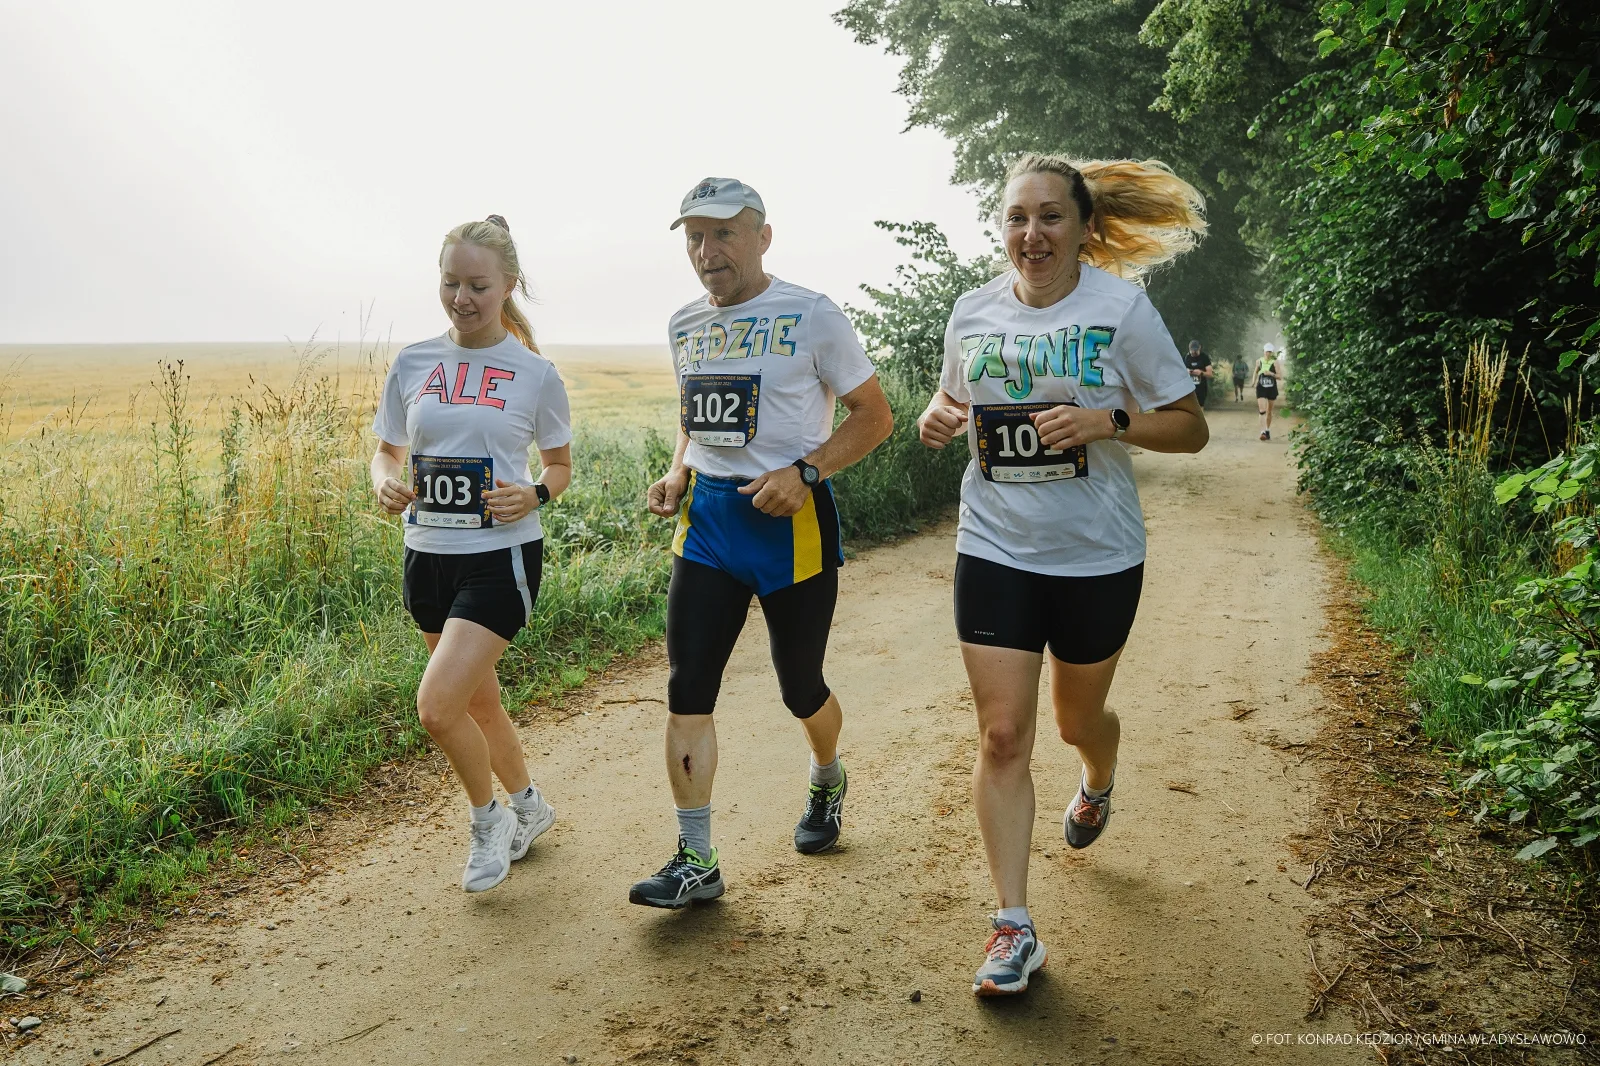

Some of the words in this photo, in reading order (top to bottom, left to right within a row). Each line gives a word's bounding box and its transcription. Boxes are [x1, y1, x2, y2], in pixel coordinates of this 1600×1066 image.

[414, 362, 516, 411] ALE
[693, 393, 740, 423] 102
[995, 424, 1063, 457] 10
[423, 474, 472, 506] 103
